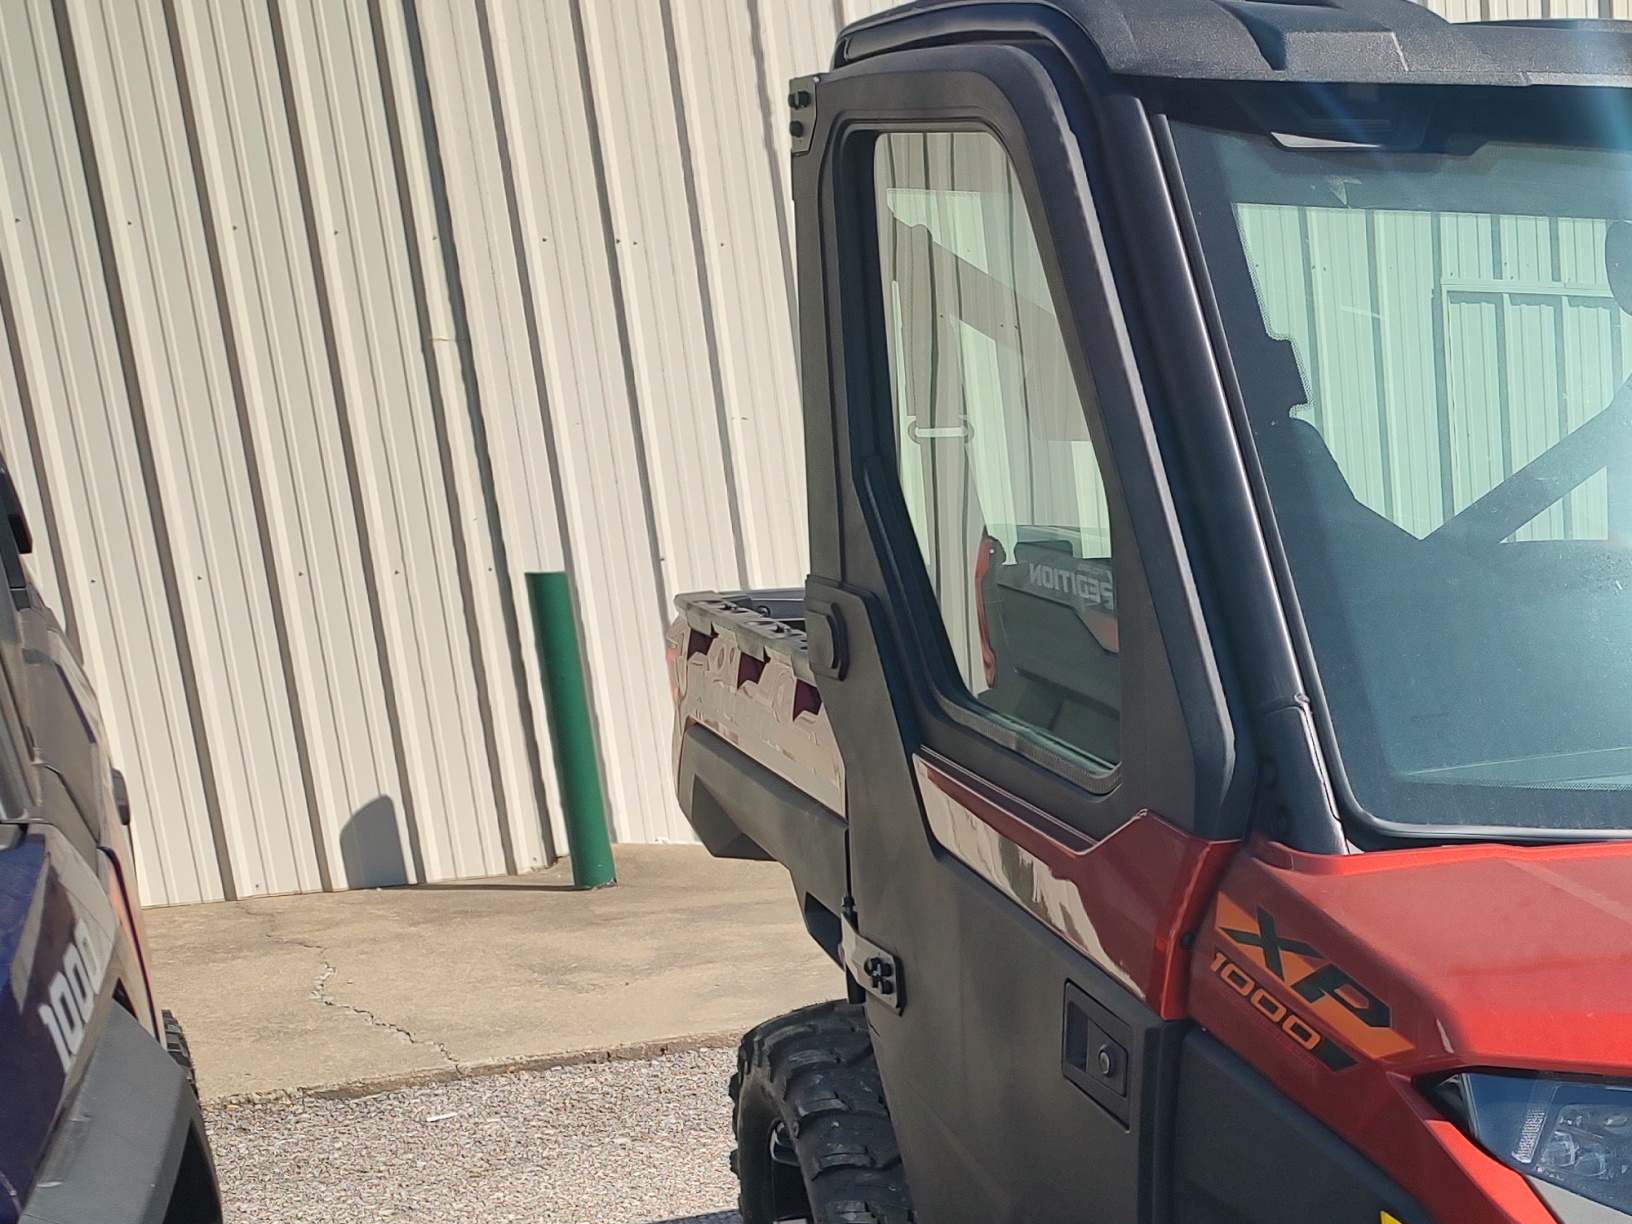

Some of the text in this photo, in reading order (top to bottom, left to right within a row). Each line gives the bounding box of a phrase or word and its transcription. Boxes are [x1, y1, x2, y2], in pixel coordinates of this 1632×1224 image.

[38, 917, 105, 1075] 1000
[1209, 951, 1322, 1051] 1000
[1218, 902, 1393, 1030] XP
